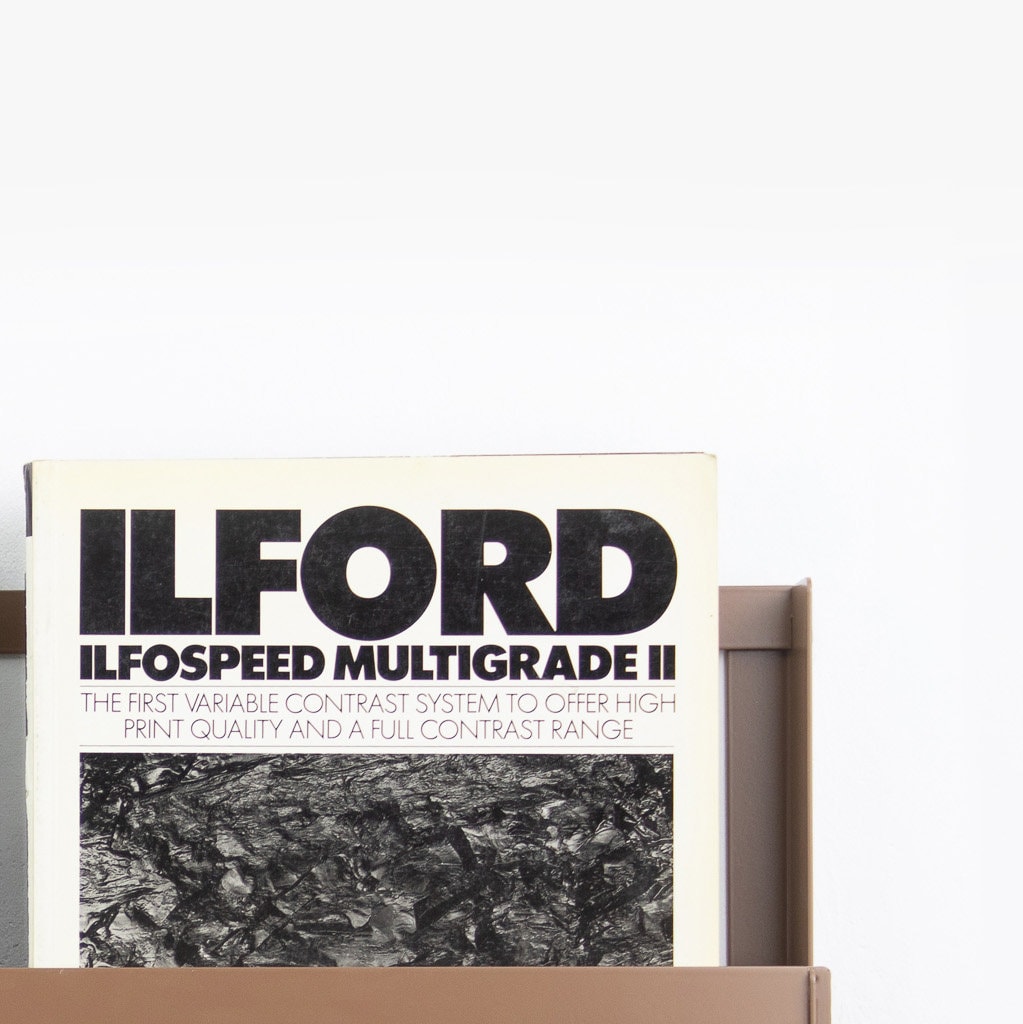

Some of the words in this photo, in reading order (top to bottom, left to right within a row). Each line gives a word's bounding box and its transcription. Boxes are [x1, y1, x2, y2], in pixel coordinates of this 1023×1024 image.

[79, 505, 678, 641] ILFORD
[79, 644, 326, 681] ILFOSPEED
[333, 644, 638, 681] MULTIGRADE
[648, 644, 676, 680] II
[80, 692, 121, 713] THE
[128, 692, 179, 713] FIRST
[184, 692, 279, 714] VARIABLE
[285, 692, 410, 714] CONTRAST
[415, 692, 500, 714] SYSTEM
[506, 692, 538, 714] TO
[544, 692, 609, 714] OFFER
[615, 692, 676, 714] HIGH
[123, 718, 184, 739] PRINT
[190, 718, 283, 741] QUALITY
[288, 718, 343, 739] AND
[348, 718, 365, 739] A
[371, 718, 414, 740] FULL
[419, 718, 545, 740] CONTRAST
[551, 718, 634, 740] RANGE
